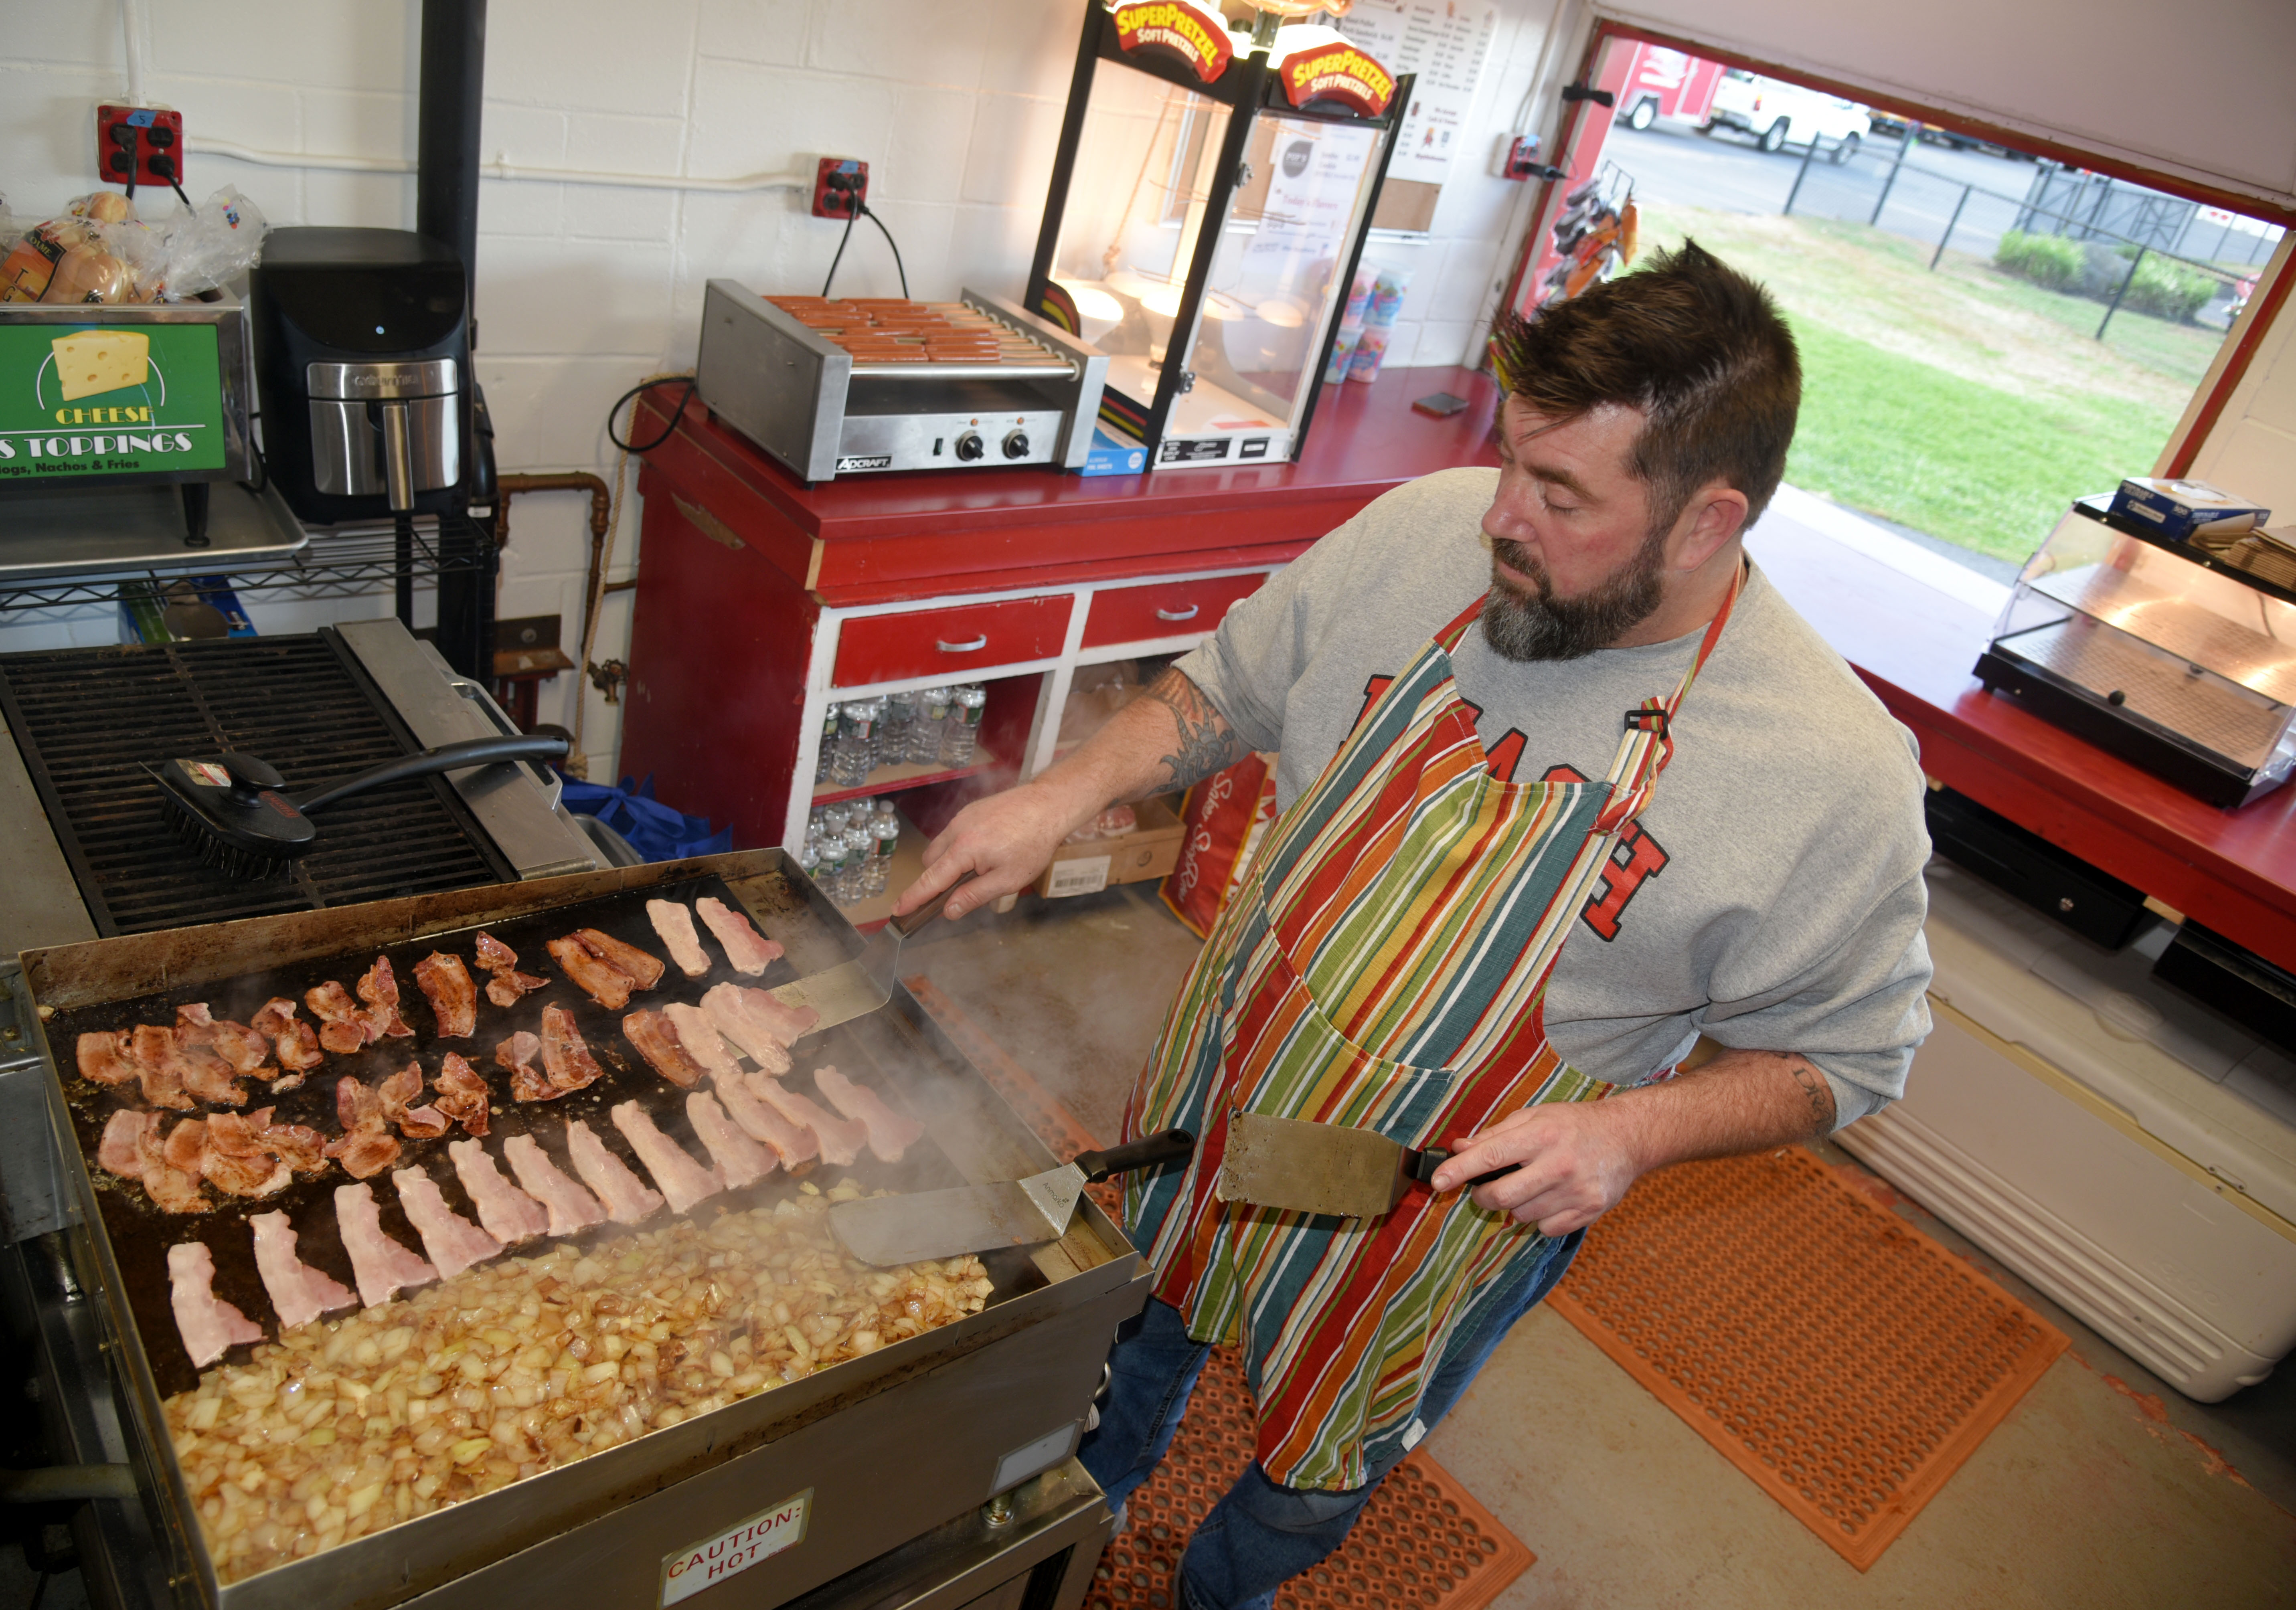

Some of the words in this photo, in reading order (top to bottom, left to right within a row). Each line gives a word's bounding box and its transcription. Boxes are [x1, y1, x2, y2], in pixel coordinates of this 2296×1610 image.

[1136, 27, 1162, 43] SOFT
[1162, 28, 1200, 63] PRETZELS
[1310, 75, 1334, 93] SOFT
[1334, 73, 1374, 101] PRETZELS
[139, 115, 146, 124] 5
[56, 407, 154, 424] CHEESE
[24, 432, 192, 458] TOPPINGS
[36, 462, 87, 473] Nachos
[92, 461, 103, 470] &
[107, 459, 140, 469] Fries
[837, 458, 889, 470] ADCRAFT
[668, 1507, 801, 1578] CAUTION:
[708, 1542, 762, 1579] HOT
